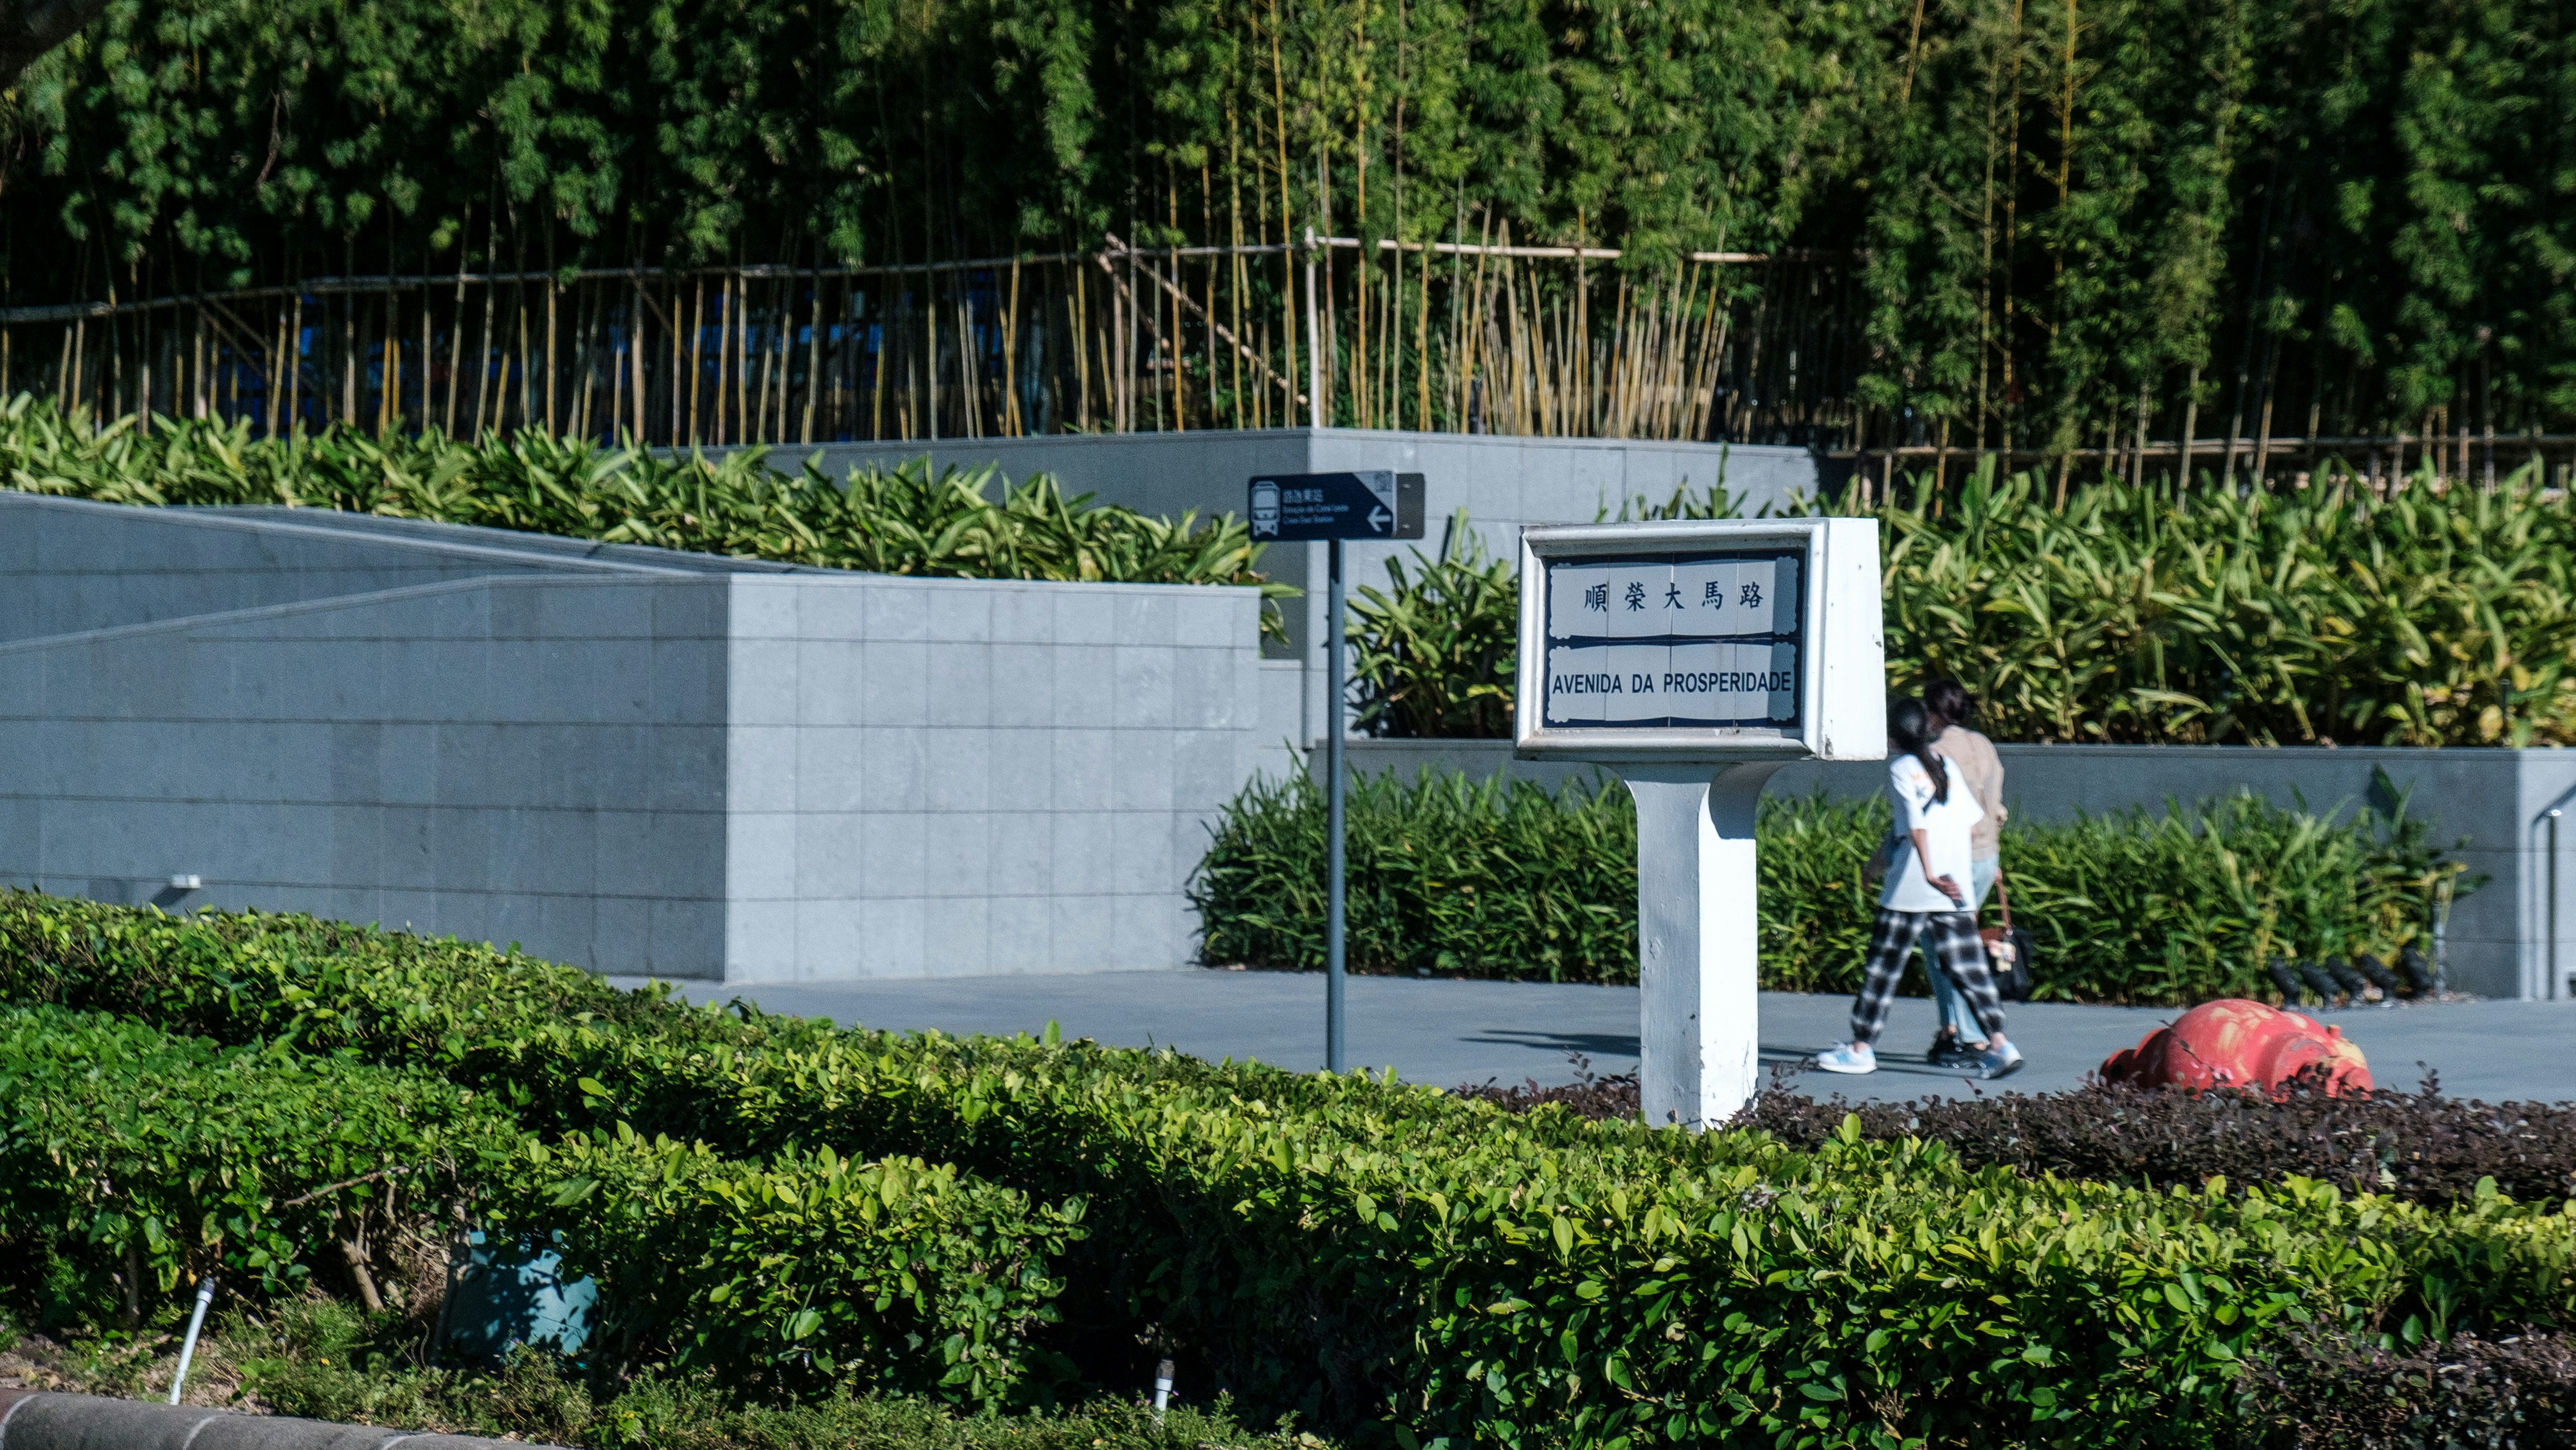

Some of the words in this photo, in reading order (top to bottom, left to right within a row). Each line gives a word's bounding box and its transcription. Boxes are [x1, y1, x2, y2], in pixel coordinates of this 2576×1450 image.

[1584, 581, 1764, 613] 順榮大馬路
[1552, 673, 1622, 694] AVENIDA
[1632, 673, 1654, 693] DA
[1664, 671, 1791, 692] PROSPERIDADE
